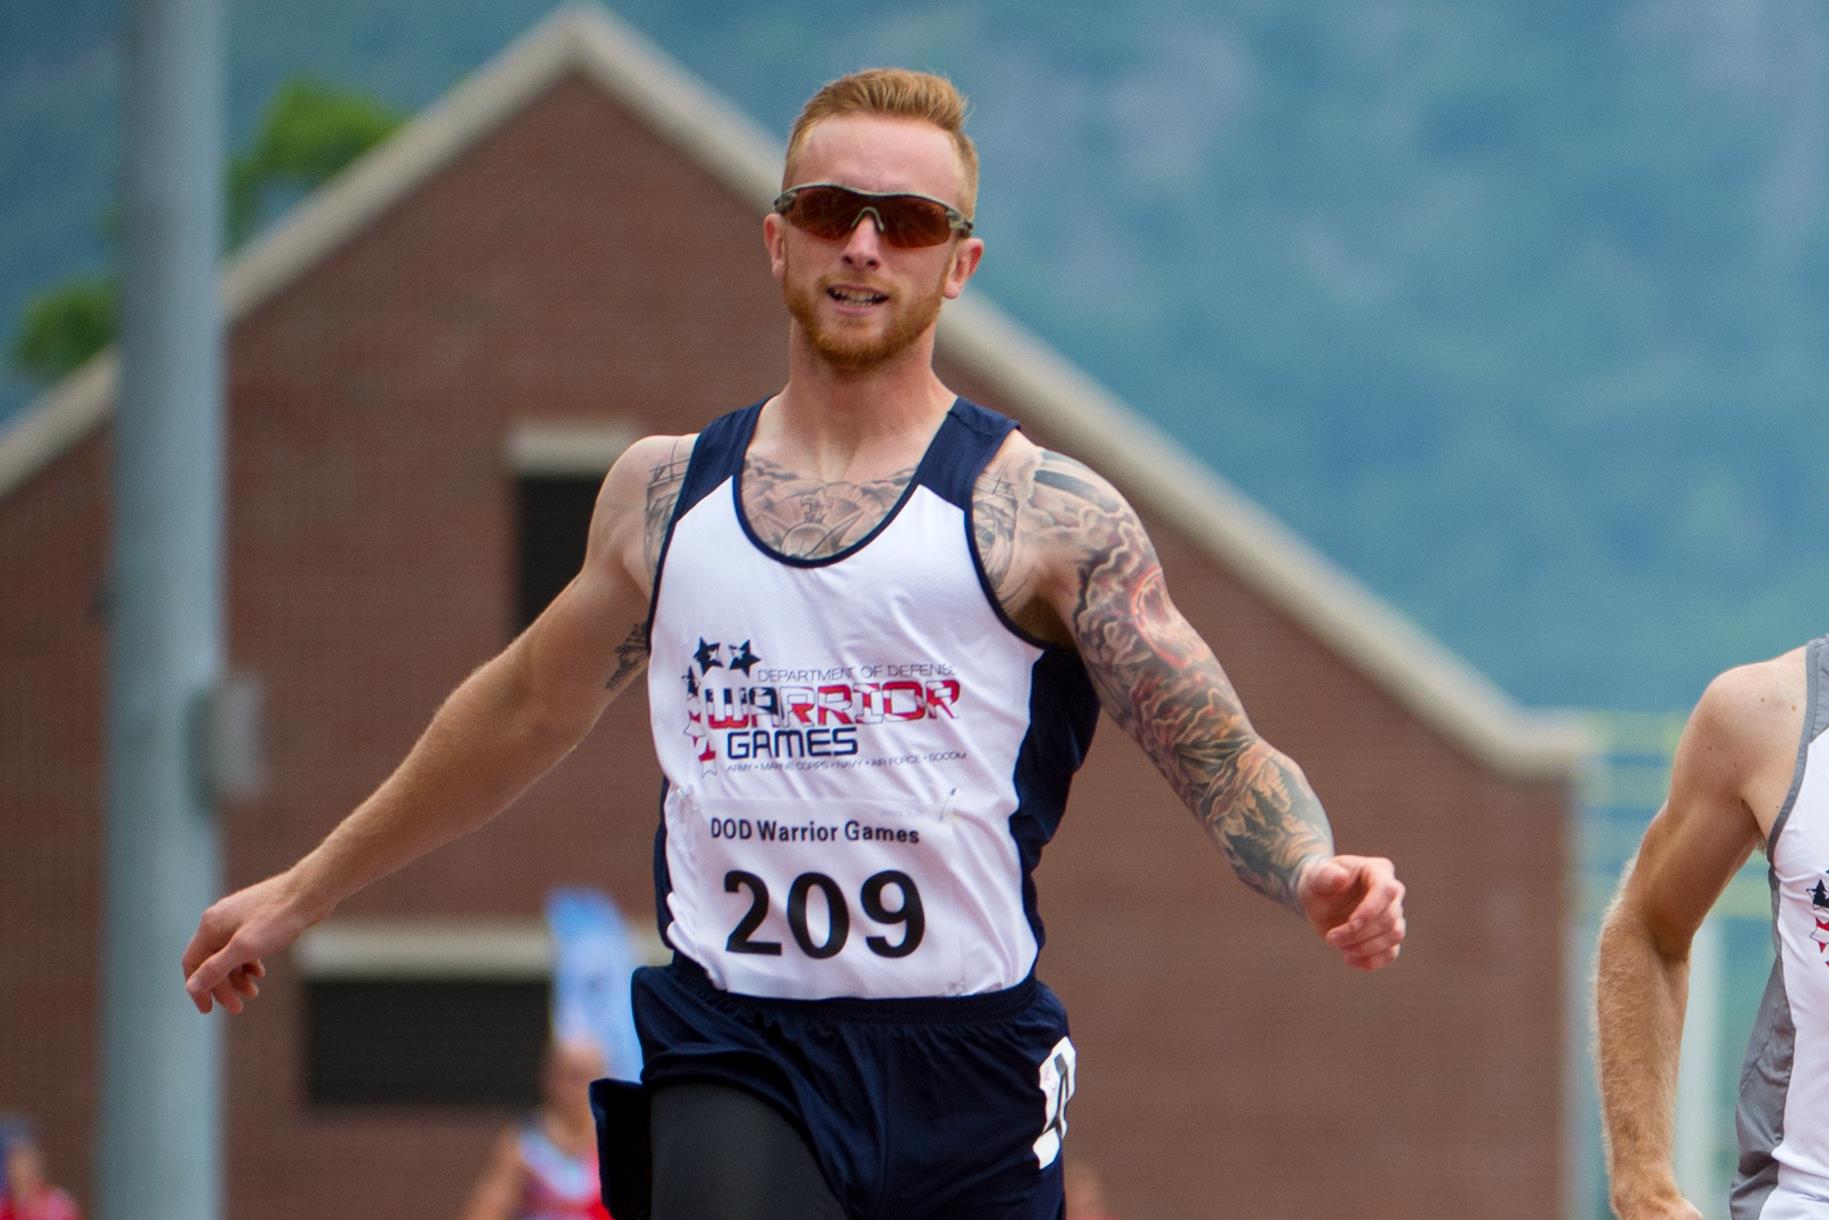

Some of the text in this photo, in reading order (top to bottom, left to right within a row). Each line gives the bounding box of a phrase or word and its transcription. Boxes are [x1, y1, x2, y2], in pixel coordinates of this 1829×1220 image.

[757, 663, 956, 683] DEPARTMENT OF DEFENS
[704, 680, 961, 729] WARRIOR
[727, 727, 859, 760] GAMES
[710, 817, 921, 844] DOD Warrior Games
[723, 869, 926, 960] 209
